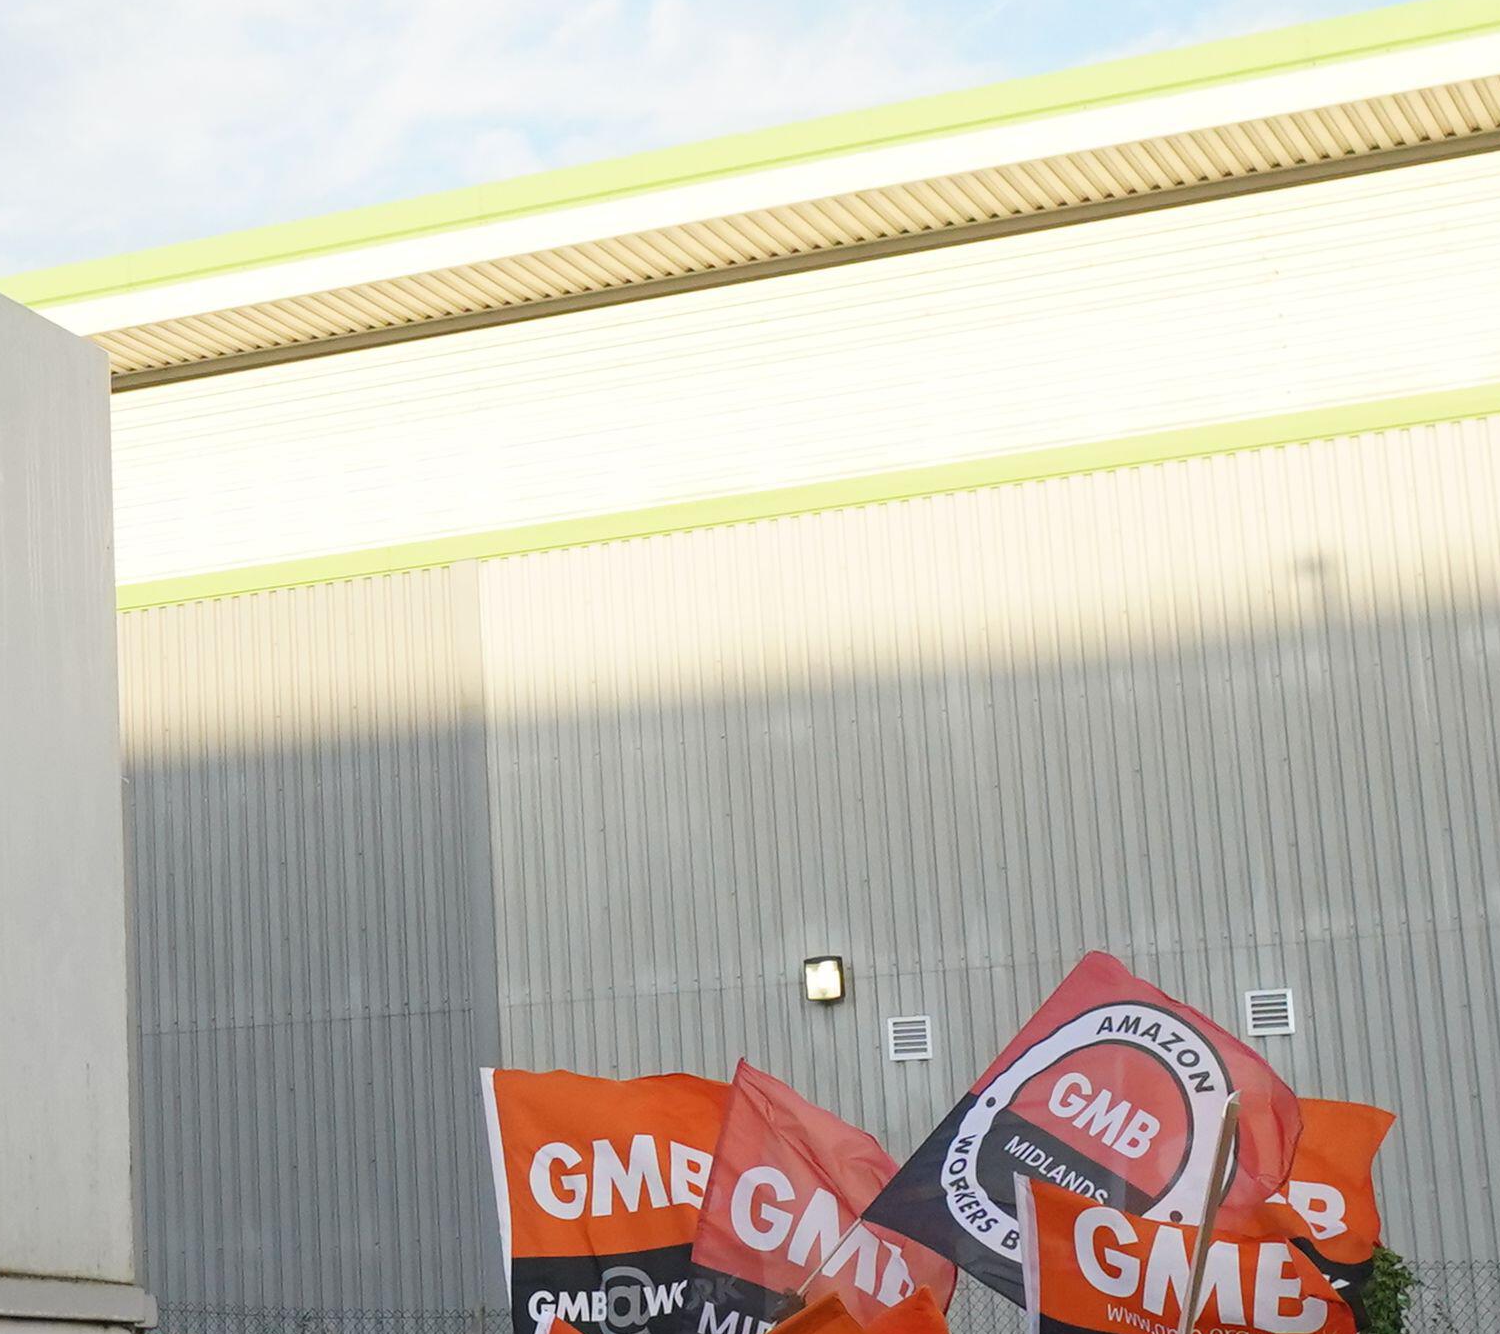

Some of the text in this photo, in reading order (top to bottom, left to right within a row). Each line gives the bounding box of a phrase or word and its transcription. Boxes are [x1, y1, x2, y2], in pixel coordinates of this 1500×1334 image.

[1096, 1014, 1215, 1095] AMAZON
[1048, 1072, 1160, 1159] GMB
[948, 1134, 999, 1234] WORKERS
[1003, 1135, 1110, 1205] MIDLANDS
[1073, 1206, 1328, 1334] GMB
